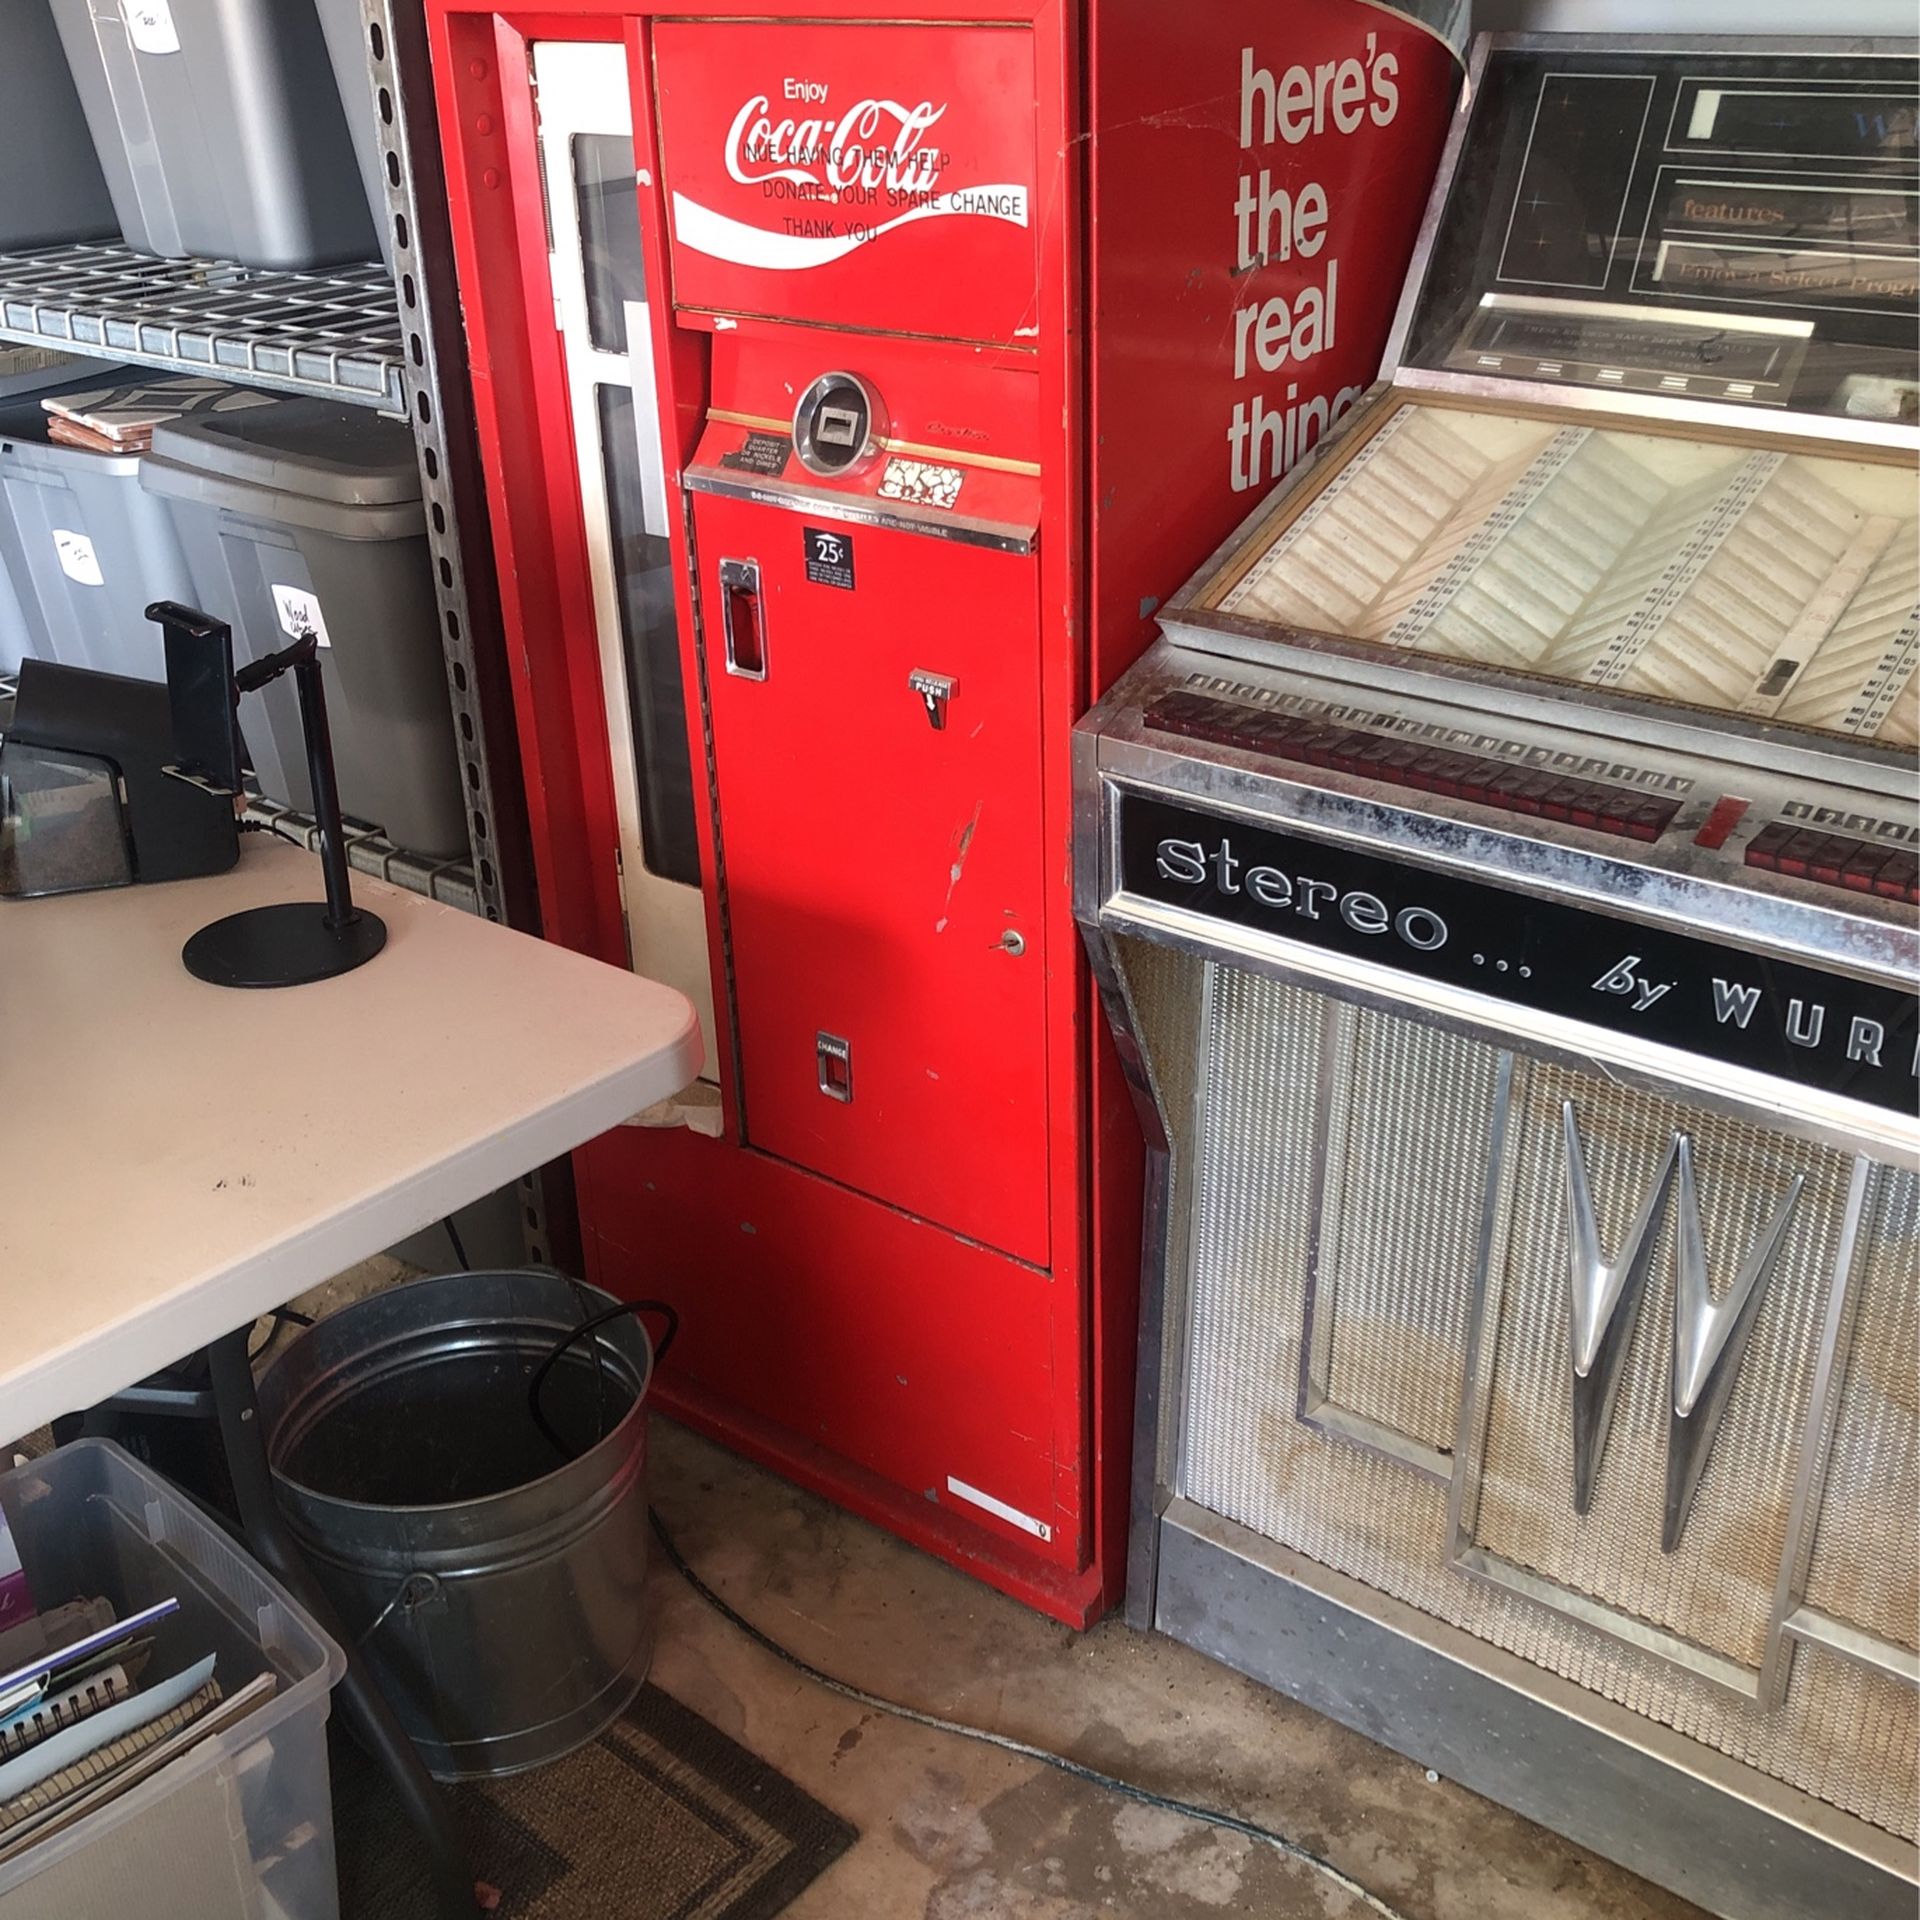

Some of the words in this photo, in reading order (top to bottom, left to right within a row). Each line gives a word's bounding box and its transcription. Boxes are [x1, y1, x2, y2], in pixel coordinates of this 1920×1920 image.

[784, 78, 828, 103] Enjoy
[1240, 31, 1399, 149] here's
[786, 145, 843, 167] HAVING
[852, 148, 899, 170] THEM
[908, 152, 950, 172] HELP
[763, 180, 825, 202] DONATE
[833, 184, 878, 206] YOUR
[887, 187, 941, 210] SPARE
[950, 192, 1022, 217] CHANGE
[1683, 199, 1785, 222] features
[783, 217, 836, 239] THANK
[844, 222, 877, 243] YOU
[1234, 169, 1328, 272] the
[1769, 270, 1841, 288] Select
[1233, 259, 1338, 379] real
[816, 540, 844, 564] 25¢
[915, 681, 942, 697] PUSH
[1887, 824, 1899, 836] 4
[1154, 836, 1448, 952] stereo
[1590, 955, 1675, 1012] by
[1711, 977, 1919, 1078] WUR
[817, 1040, 847, 1059] CHANGE
